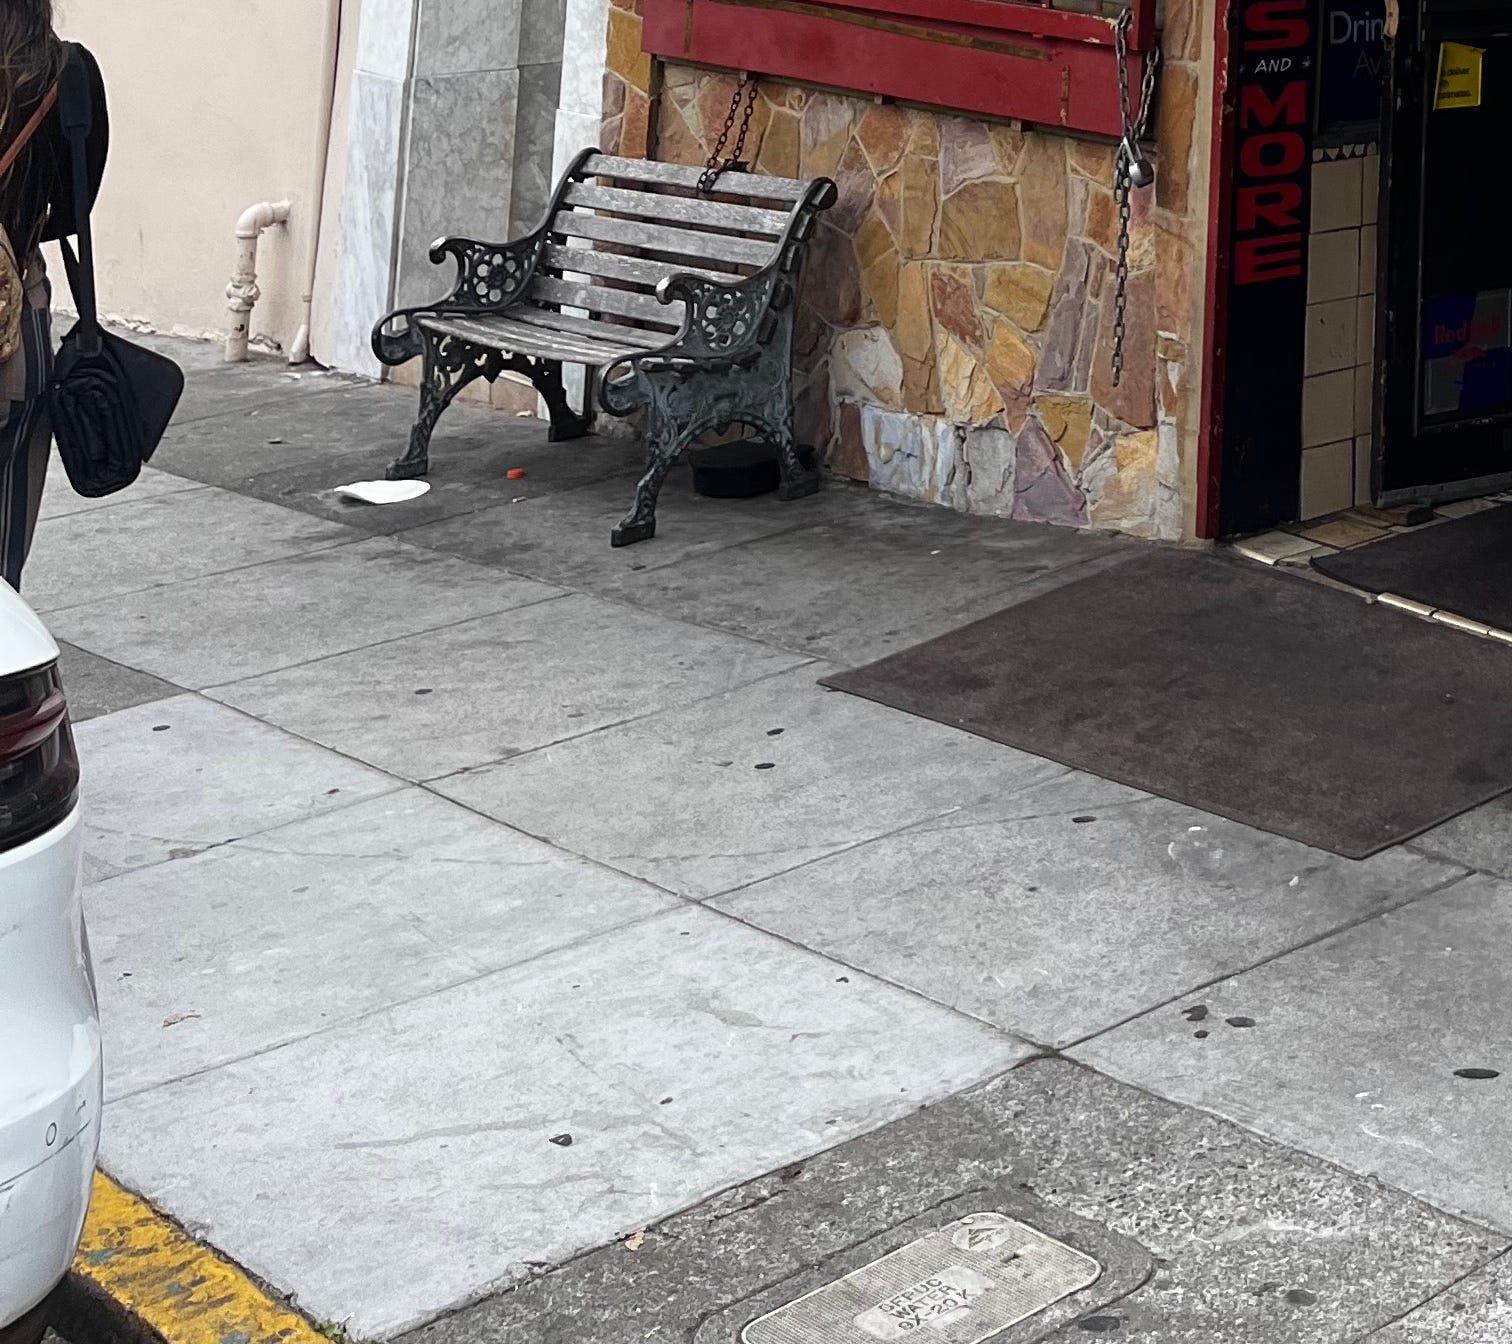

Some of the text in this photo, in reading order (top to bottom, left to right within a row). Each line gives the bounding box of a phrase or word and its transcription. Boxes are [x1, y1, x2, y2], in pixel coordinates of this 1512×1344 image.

[1253, 55, 1293, 75] AND
[1233, 80, 1308, 287] MORE
[888, 1285, 957, 1319] WATER
